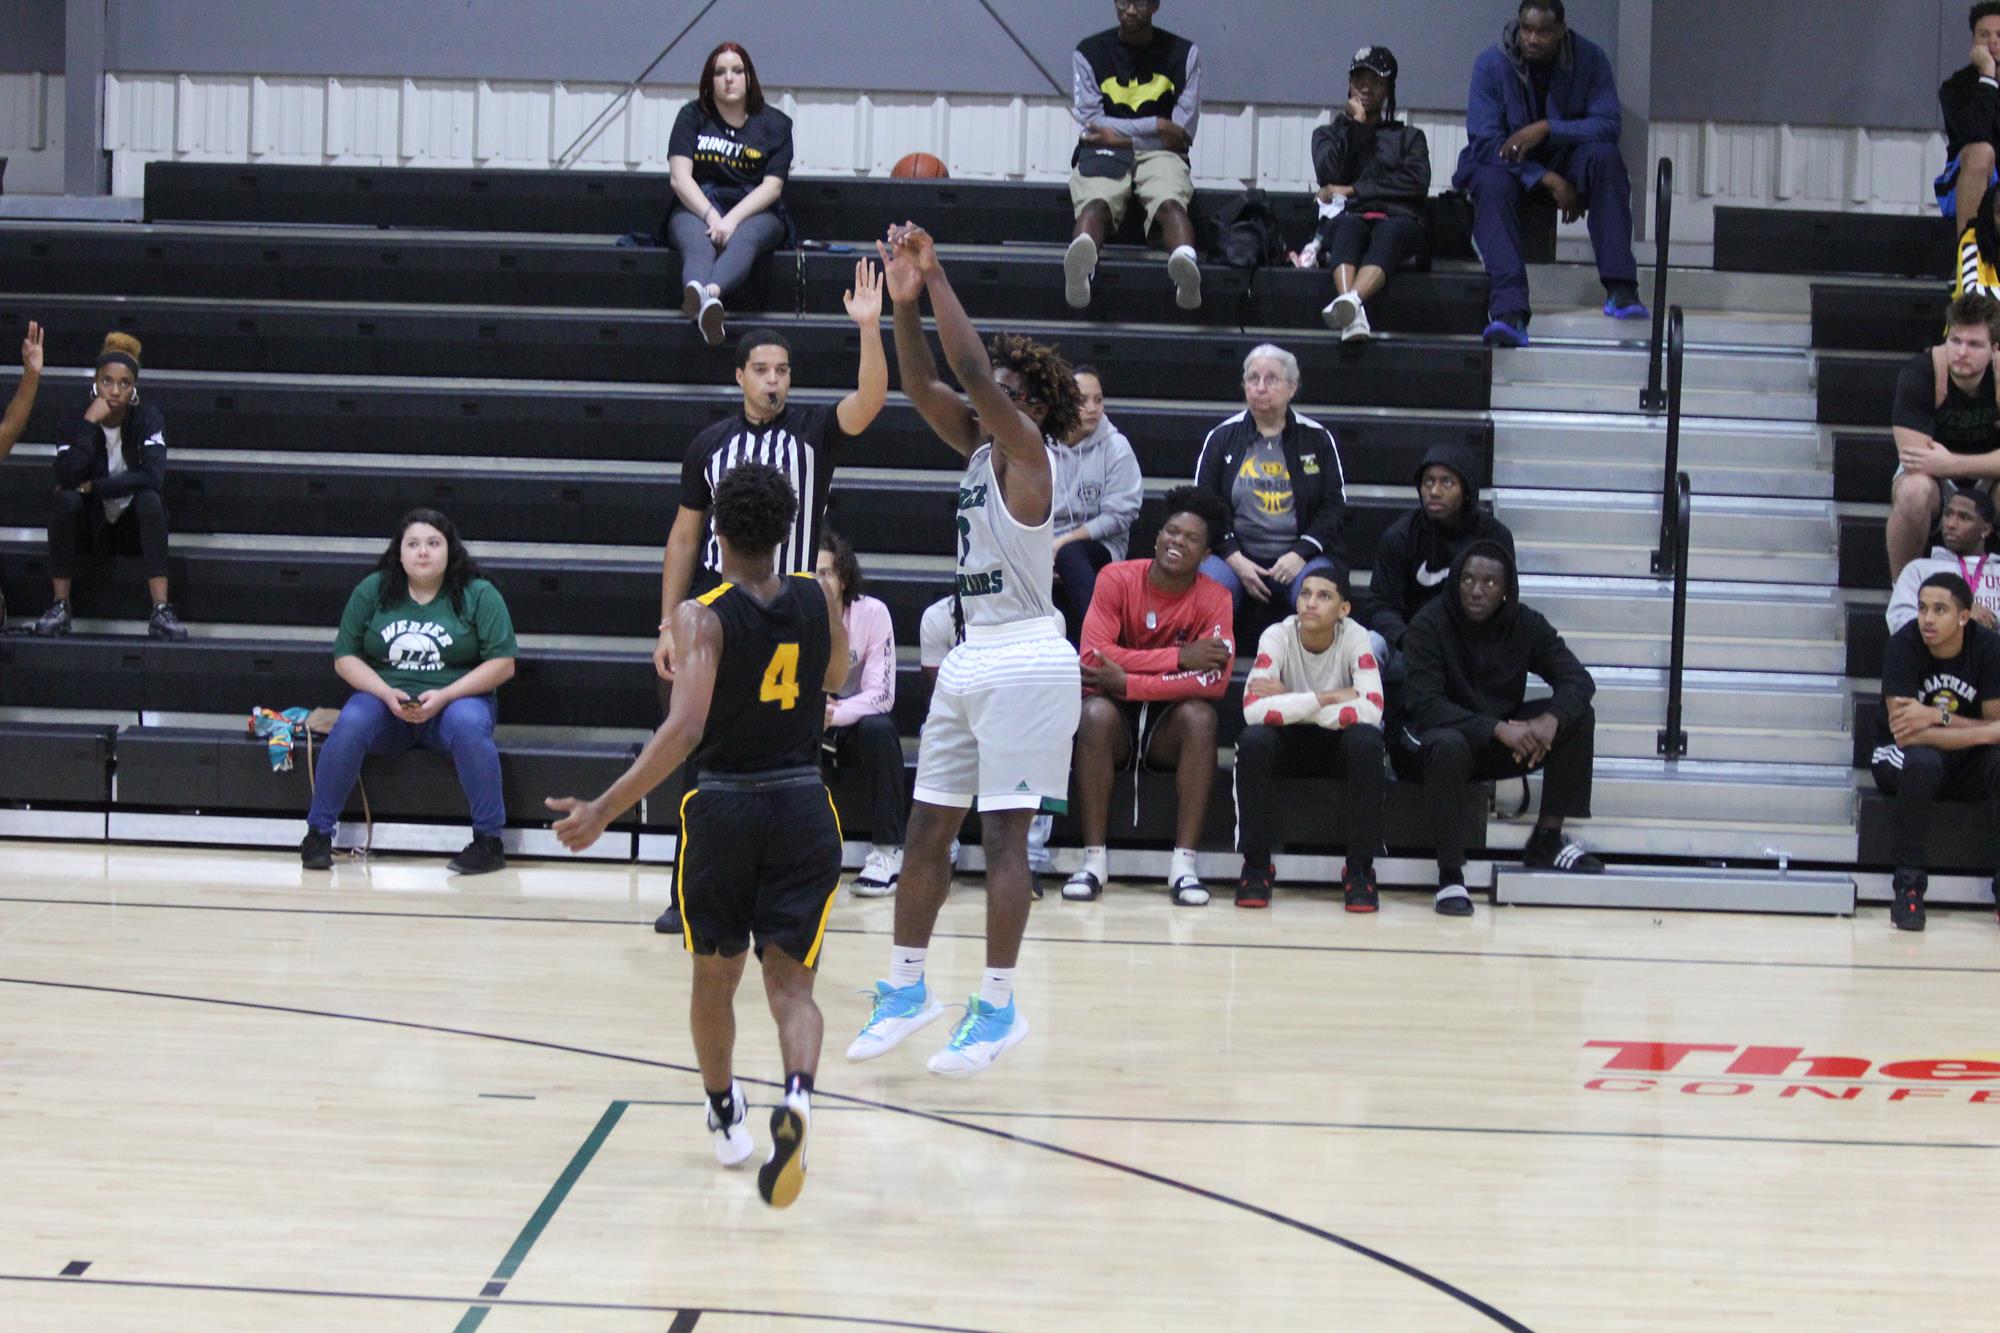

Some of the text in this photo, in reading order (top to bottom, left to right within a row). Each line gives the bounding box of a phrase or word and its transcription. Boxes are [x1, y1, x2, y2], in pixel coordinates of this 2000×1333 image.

[697, 134, 744, 158] TRINITY
[760, 643, 799, 710] 4
[1583, 1040, 2000, 1081] The
